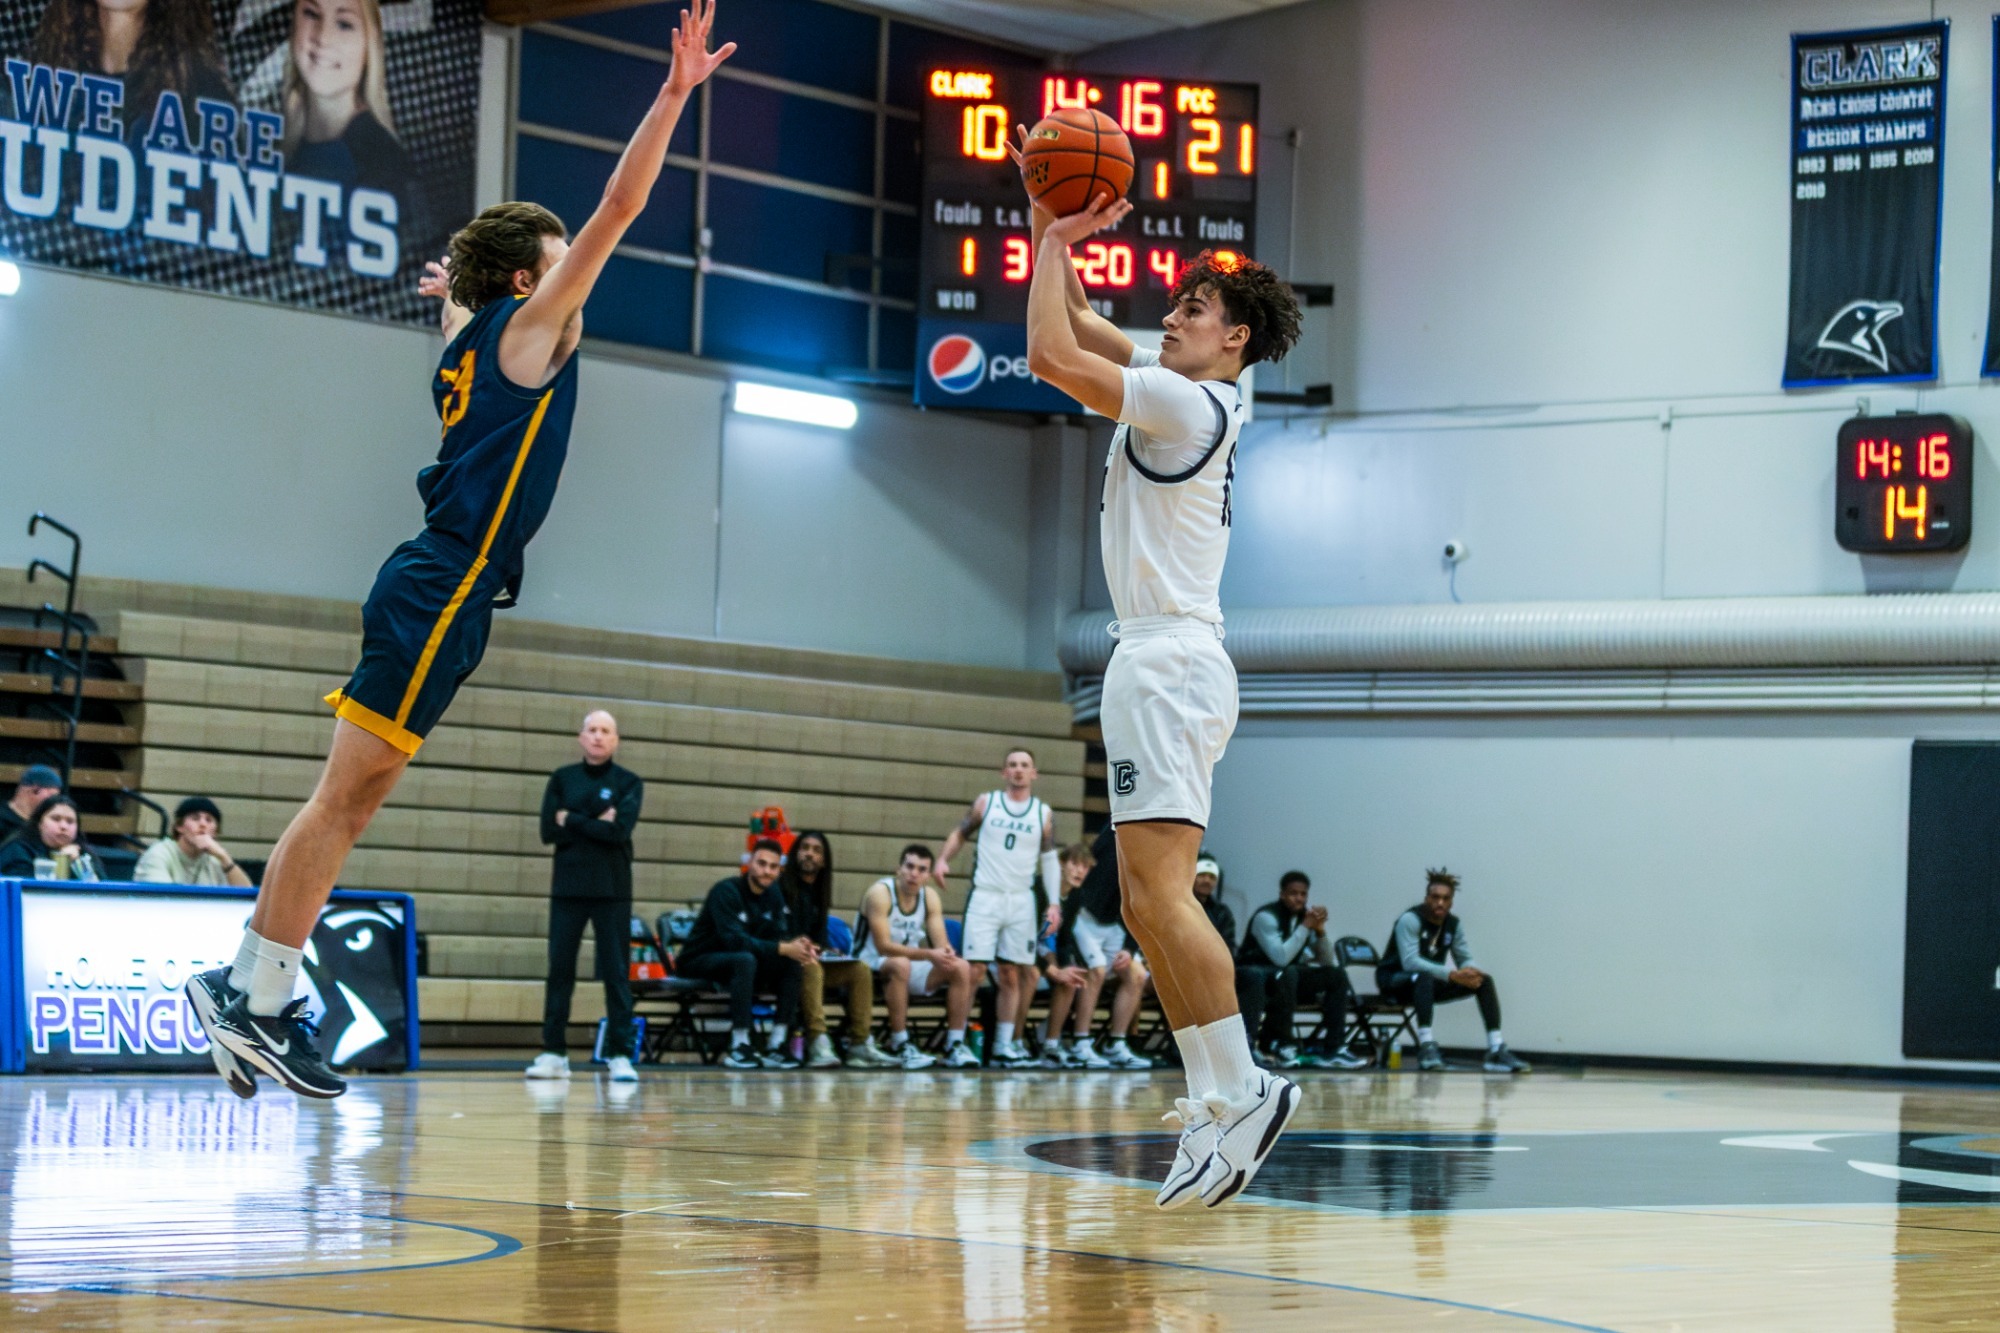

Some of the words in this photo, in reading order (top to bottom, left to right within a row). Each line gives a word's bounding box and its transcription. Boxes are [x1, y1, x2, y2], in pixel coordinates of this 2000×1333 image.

[1803, 38, 1938, 88] CLARK
[930, 69, 993, 100] CLARK
[5, 57, 124, 141] WE
[143, 90, 285, 172] ARE
[1176, 86, 1216, 115] PCC
[1839, 93, 1877, 116] CROSS
[1880, 86, 1935, 112] COUNTRY
[962, 104, 1007, 160] 10
[1187, 118, 1253, 175] 21
[1806, 126, 1860, 148] REGION
[1864, 119, 1926, 144] CHAMPS
[1155, 161, 1168, 199] 1
[1796, 181, 1826, 199] 2010
[935, 199, 981, 226] fouls
[1198, 215, 1244, 241] fouls
[962, 237, 975, 276] 1
[1004, 238, 1029, 281] 3
[1151, 249, 1175, 286] 4
[937, 290, 976, 310] won
[1884, 484, 1927, 541] 14
[991, 818, 1035, 834] CLARK
[1005, 833, 1016, 850] 0
[47, 955, 147, 991] HOME
